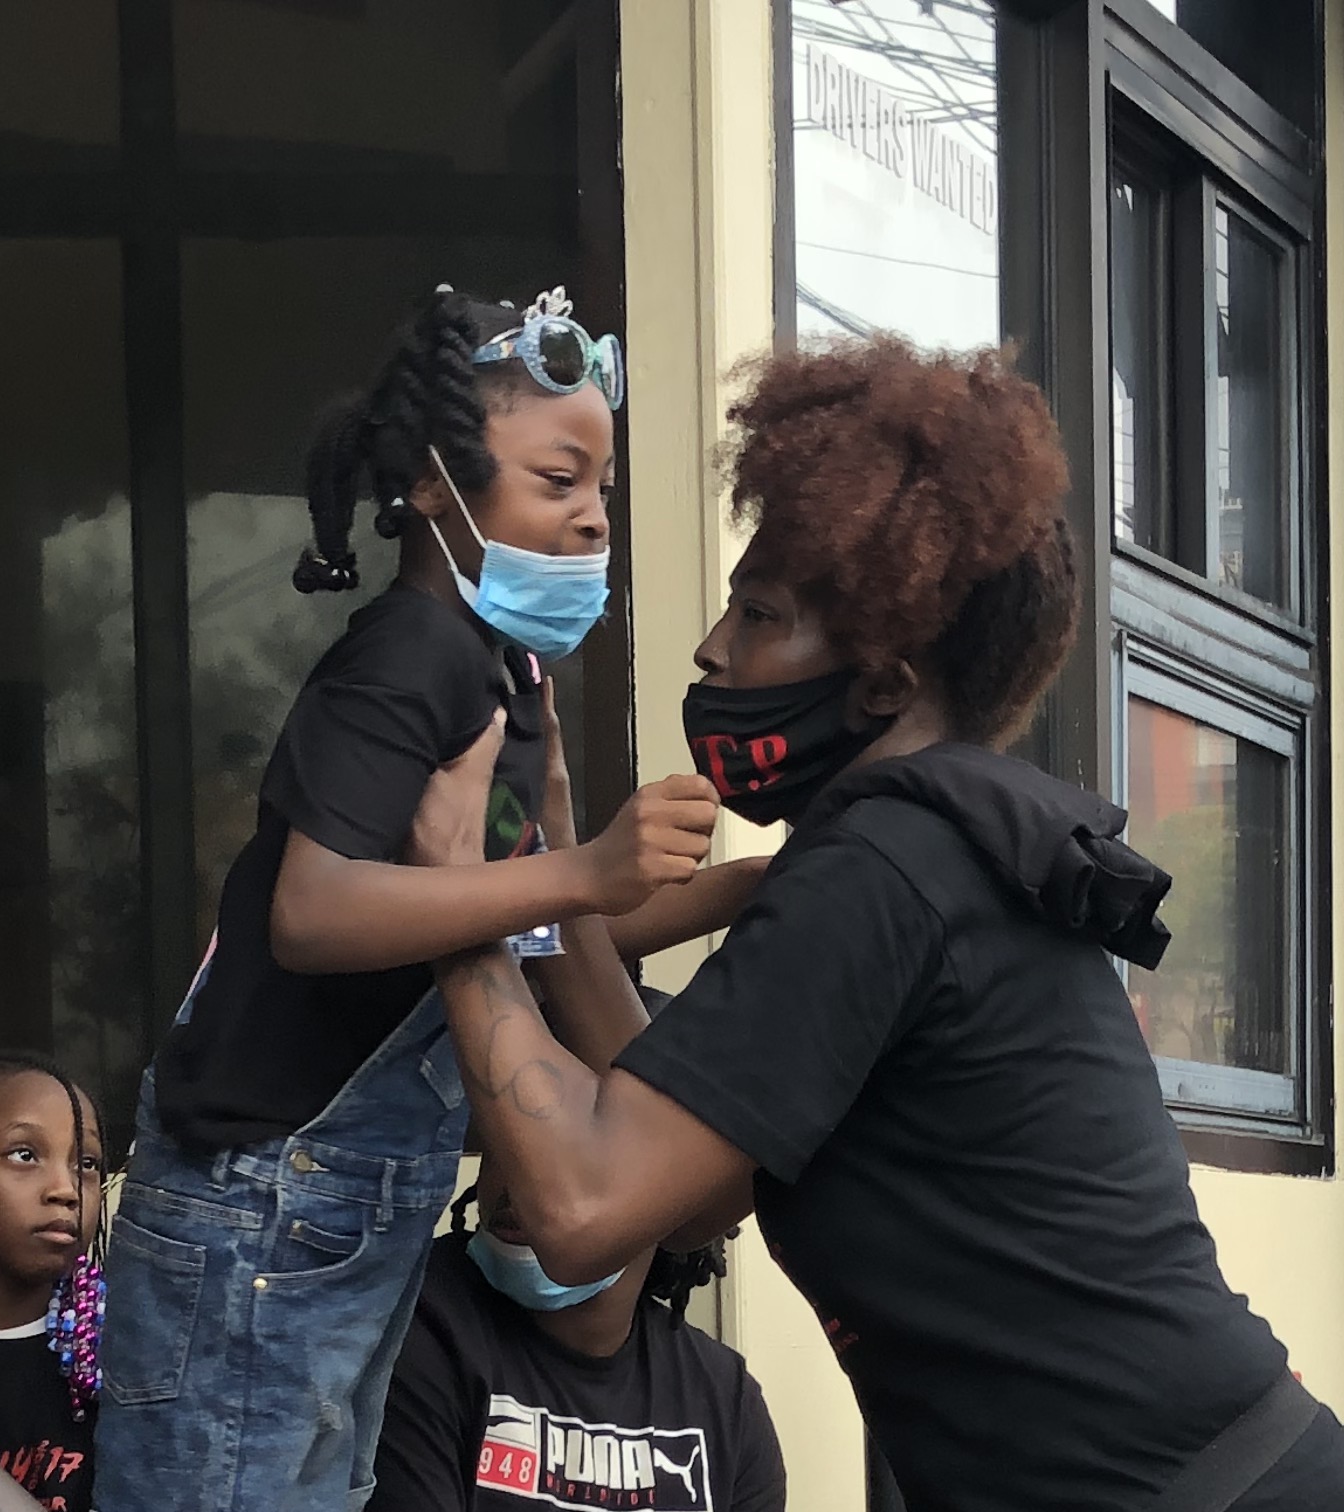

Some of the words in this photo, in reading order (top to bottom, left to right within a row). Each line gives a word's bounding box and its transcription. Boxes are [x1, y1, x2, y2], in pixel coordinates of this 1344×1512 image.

[807, 43, 906, 178] DRIVERS
[910, 112, 997, 236] WANTED
[546, 1421, 655, 1490] PUMA
